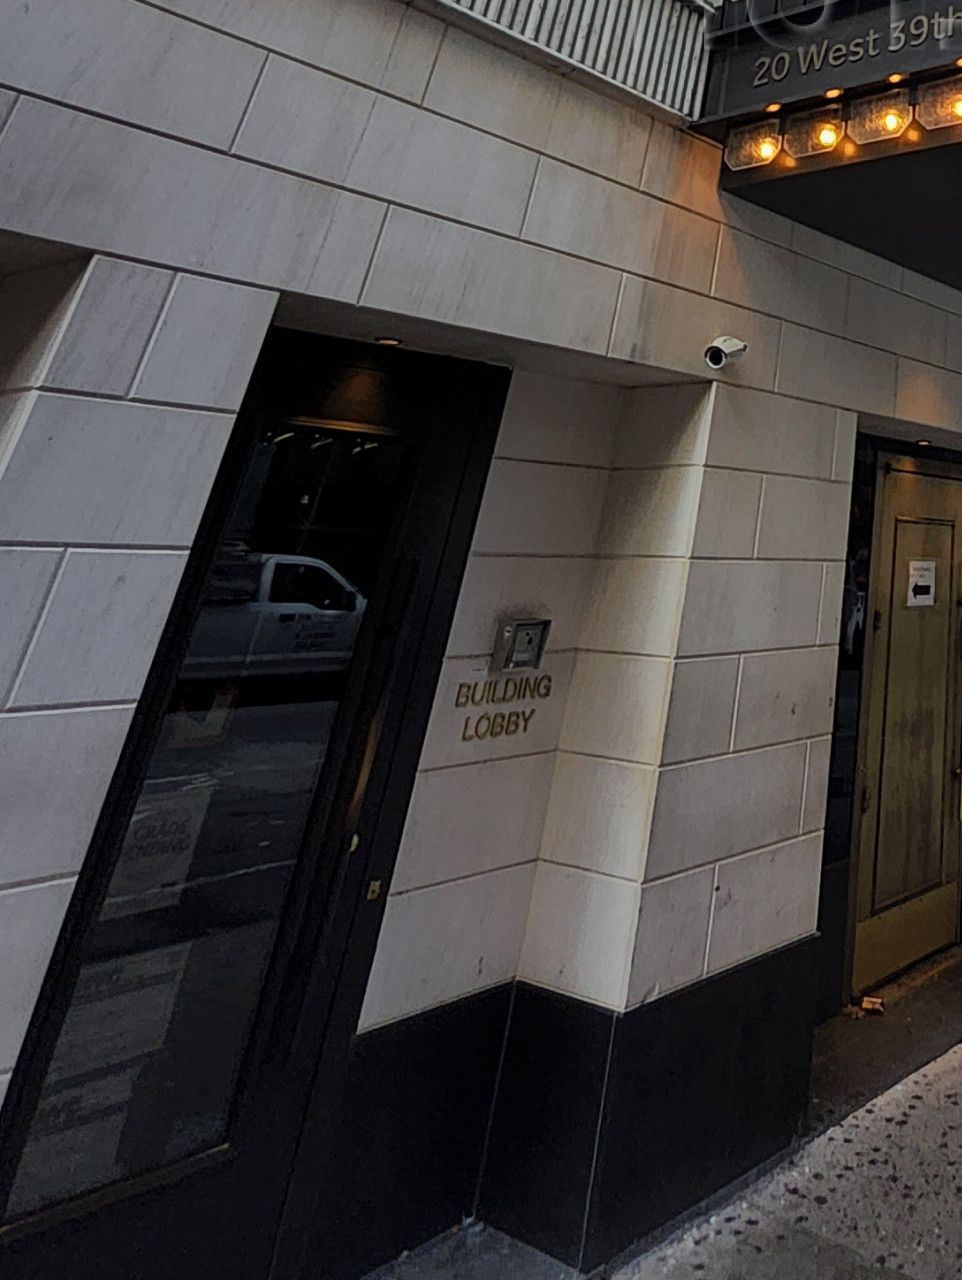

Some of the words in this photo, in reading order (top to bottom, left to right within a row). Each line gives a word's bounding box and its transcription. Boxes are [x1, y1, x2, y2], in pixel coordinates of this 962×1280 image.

[753, 51, 791, 87] 20
[797, 29, 881, 74] West
[455, 674, 552, 708] BUILDING
[462, 708, 536, 742] LOBBY
